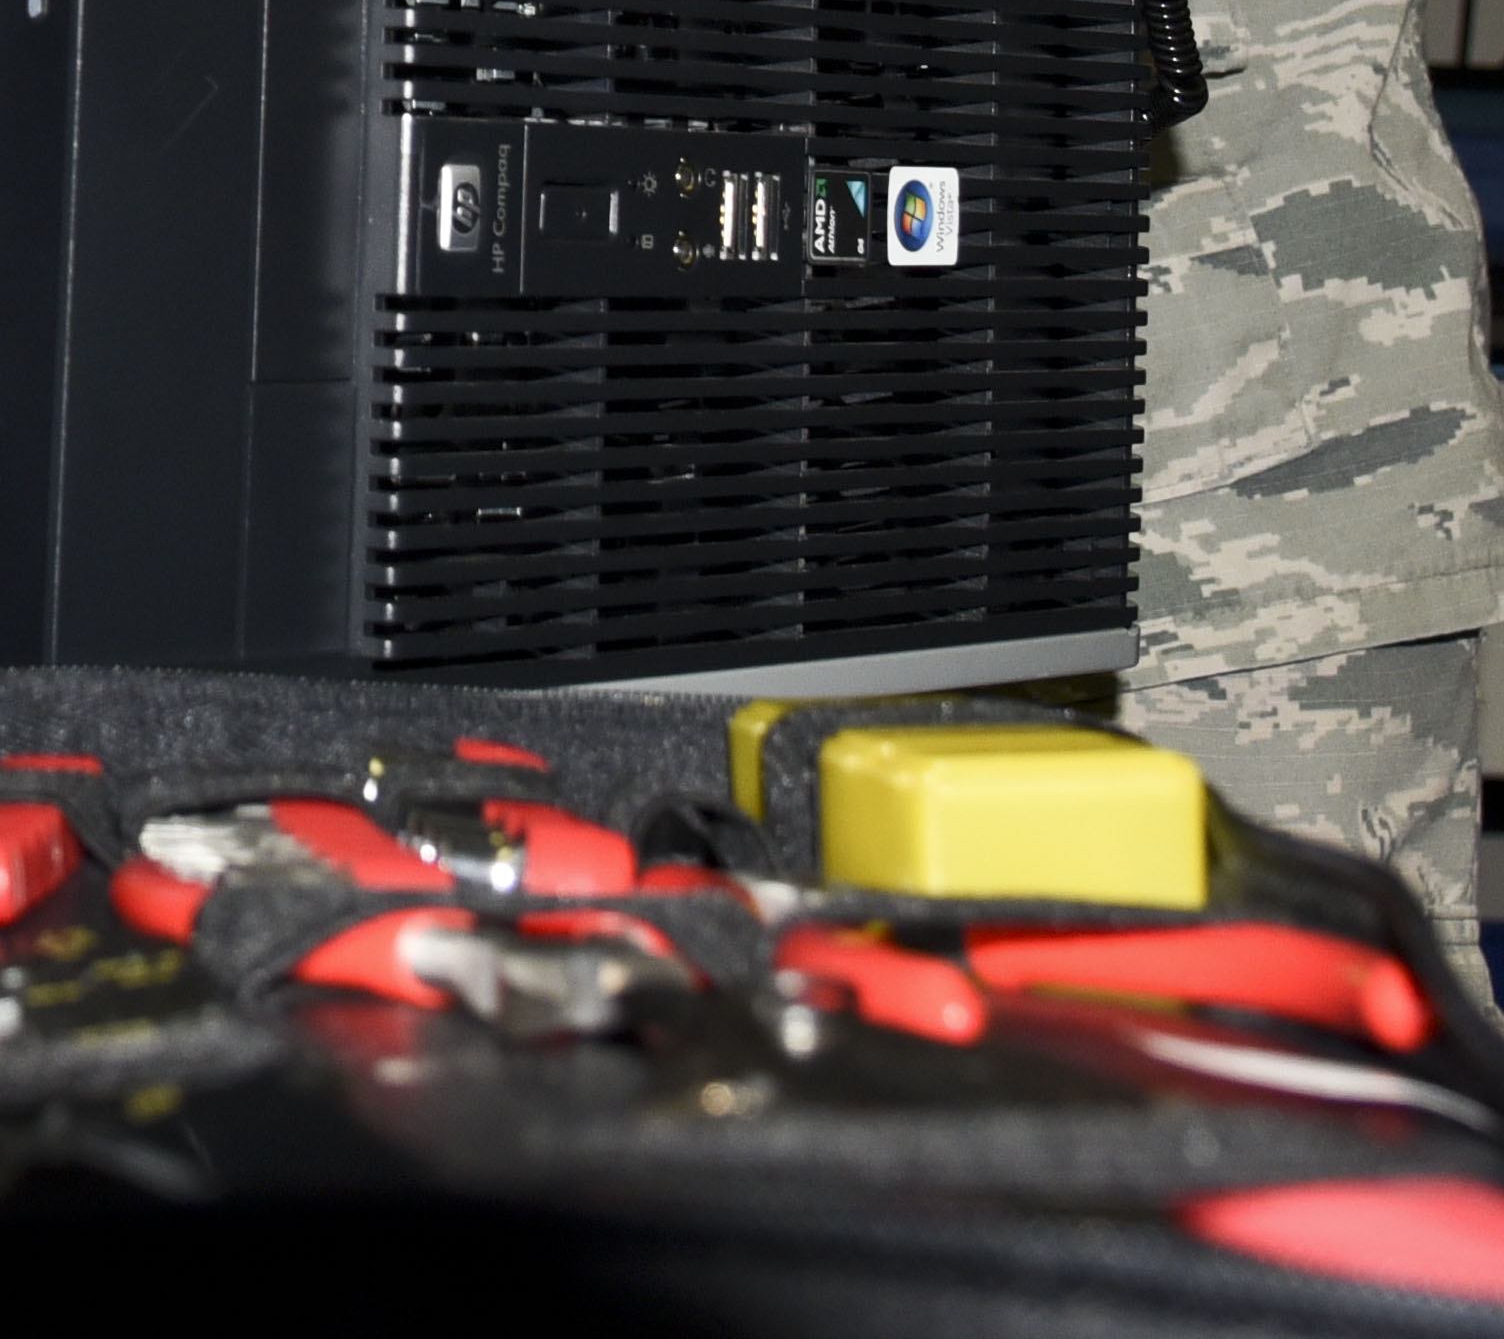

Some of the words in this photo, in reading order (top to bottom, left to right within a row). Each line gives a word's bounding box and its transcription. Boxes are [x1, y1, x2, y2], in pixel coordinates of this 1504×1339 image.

[452, 187, 479, 228] hp
[493, 144, 512, 237] Compaq
[935, 181, 946, 253] Windows
[814, 199, 826, 254] AMD
[492, 242, 505, 274] HP
